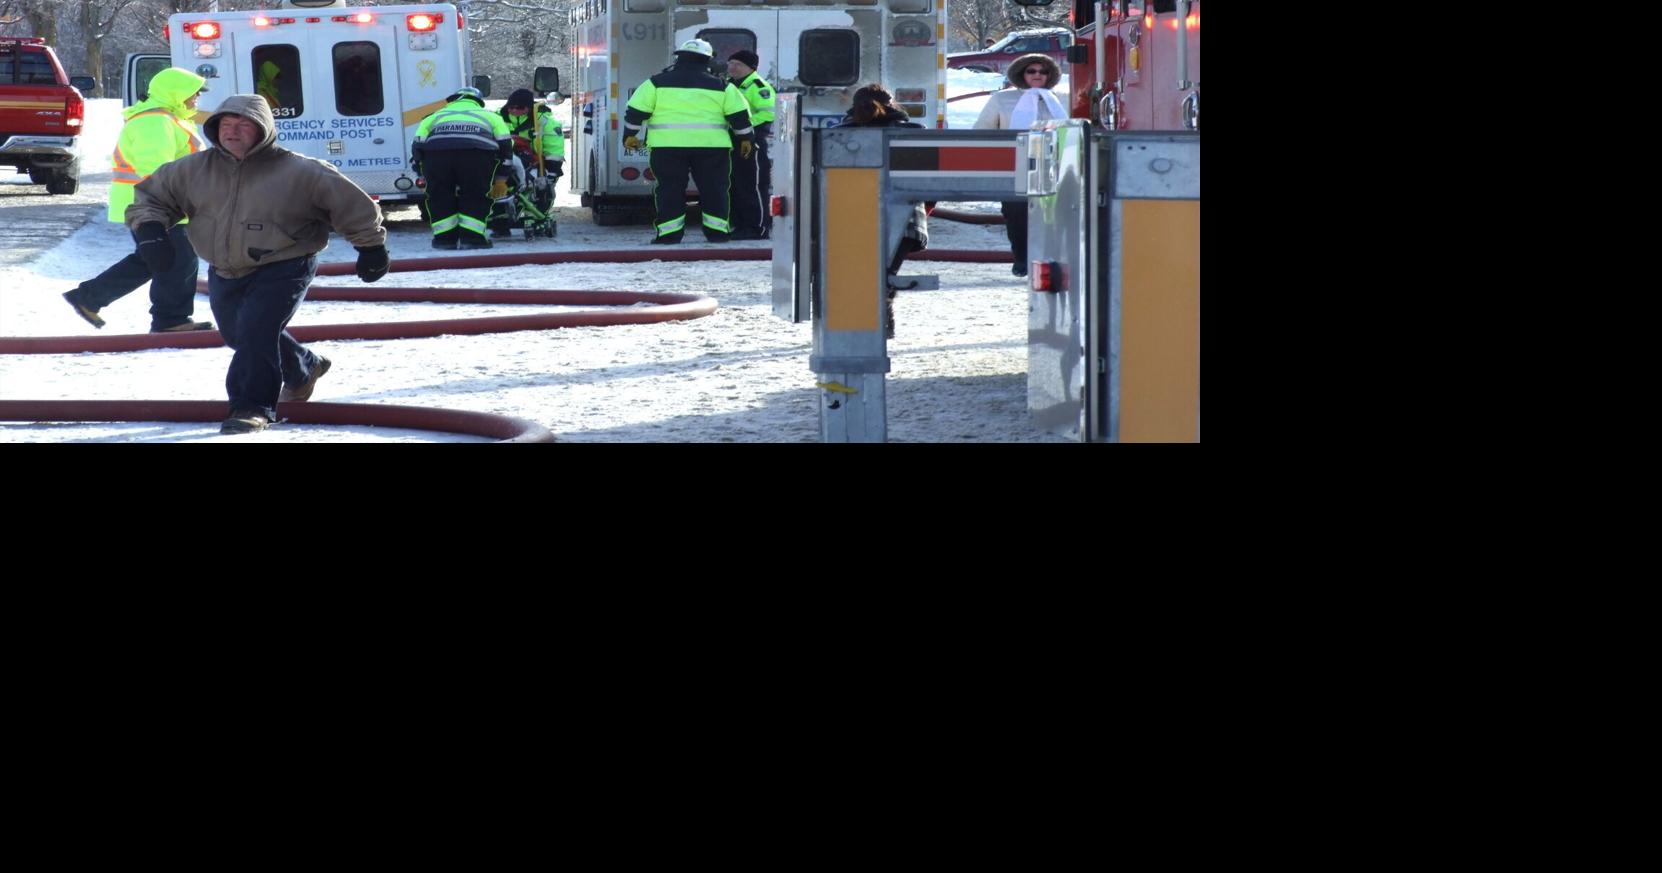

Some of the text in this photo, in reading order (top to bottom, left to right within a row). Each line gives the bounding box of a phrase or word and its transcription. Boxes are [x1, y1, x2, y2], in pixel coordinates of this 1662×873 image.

[633, 22, 666, 41] 911
[331, 117, 394, 129] SERVICES
[435, 124, 480, 132] PARAMEDIC
[340, 128, 374, 139] POST
[348, 156, 401, 167] METRES
